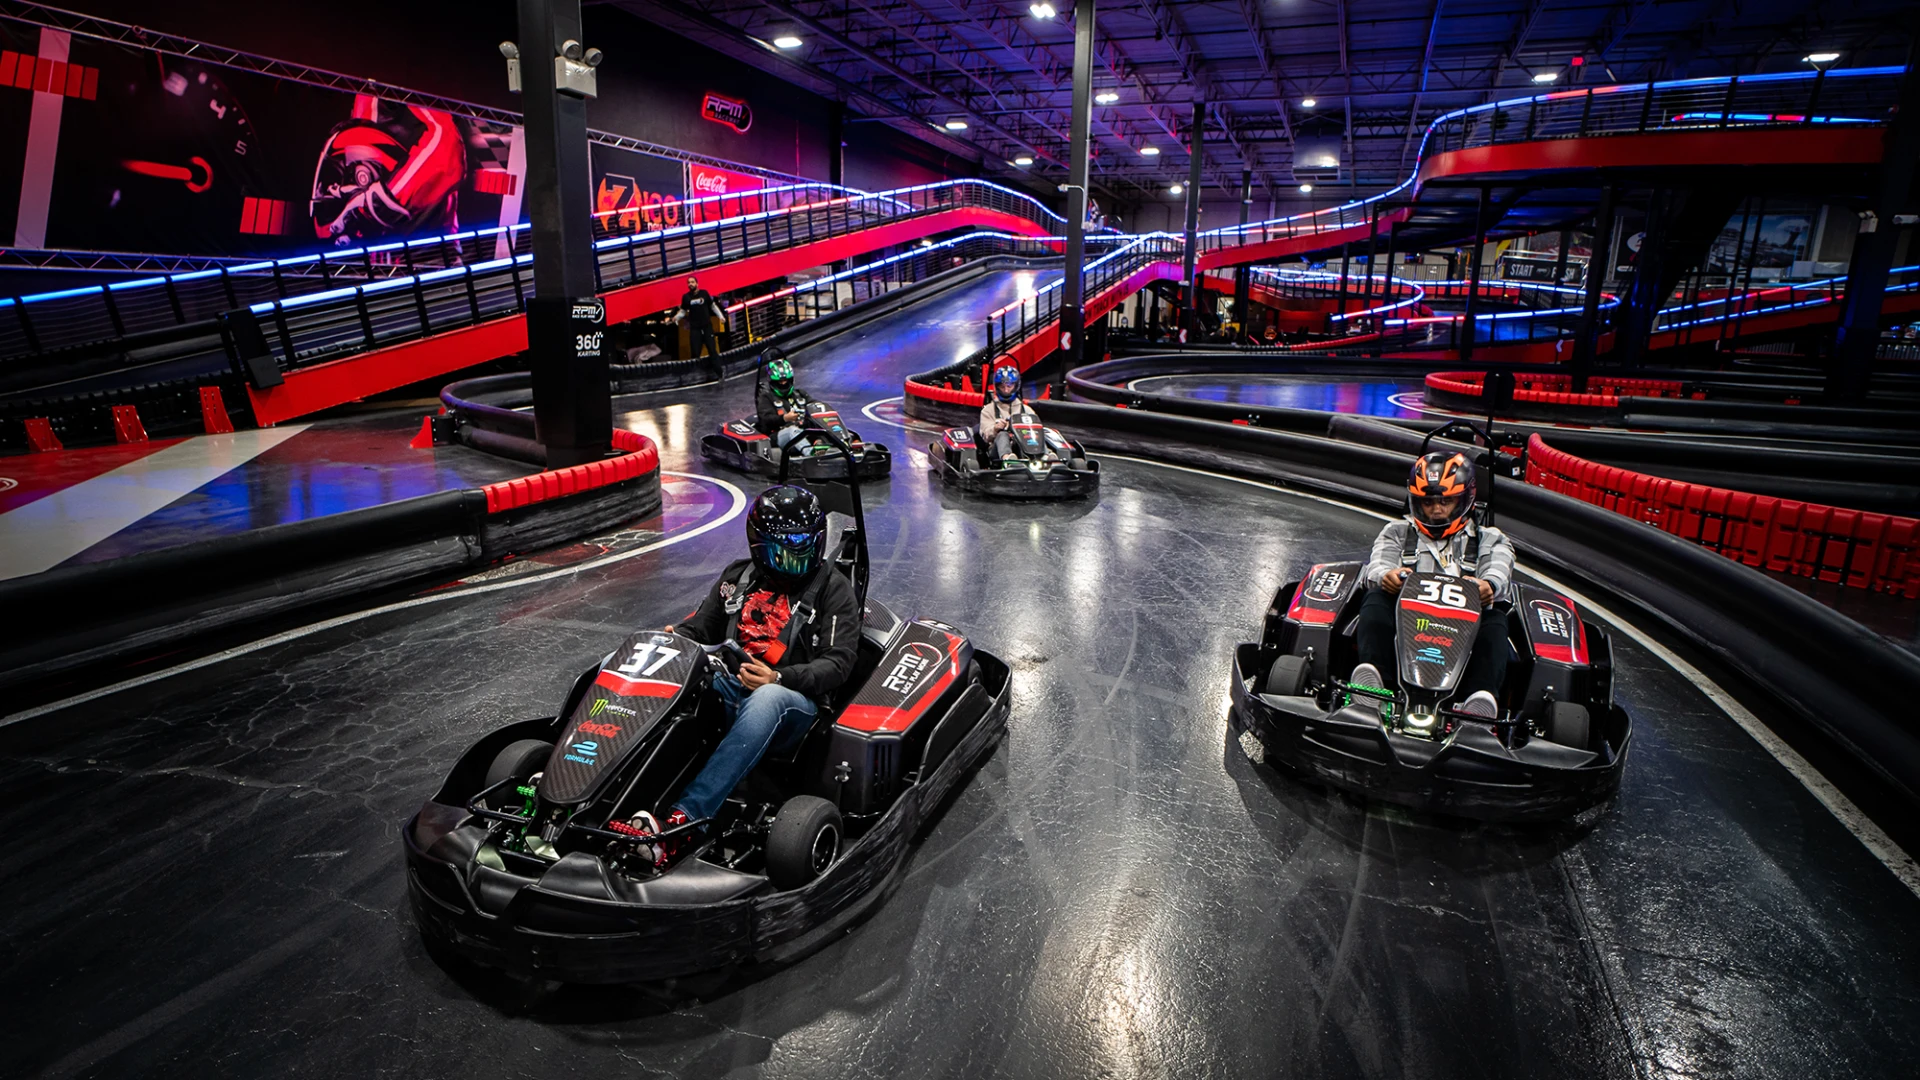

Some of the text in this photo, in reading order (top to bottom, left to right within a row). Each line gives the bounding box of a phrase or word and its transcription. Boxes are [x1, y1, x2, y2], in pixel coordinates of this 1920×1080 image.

[706, 96, 742, 118] RPM
[1510, 263, 1534, 277] START
[572, 305, 596, 315] RPM
[1321, 572, 1345, 594] RPM
[1417, 579, 1467, 608] 36
[1537, 608, 1560, 636] RPM
[617, 642, 681, 677] 37
[881, 653, 921, 692] RPM
[900, 658, 930, 695] RACE PLAY MORE
